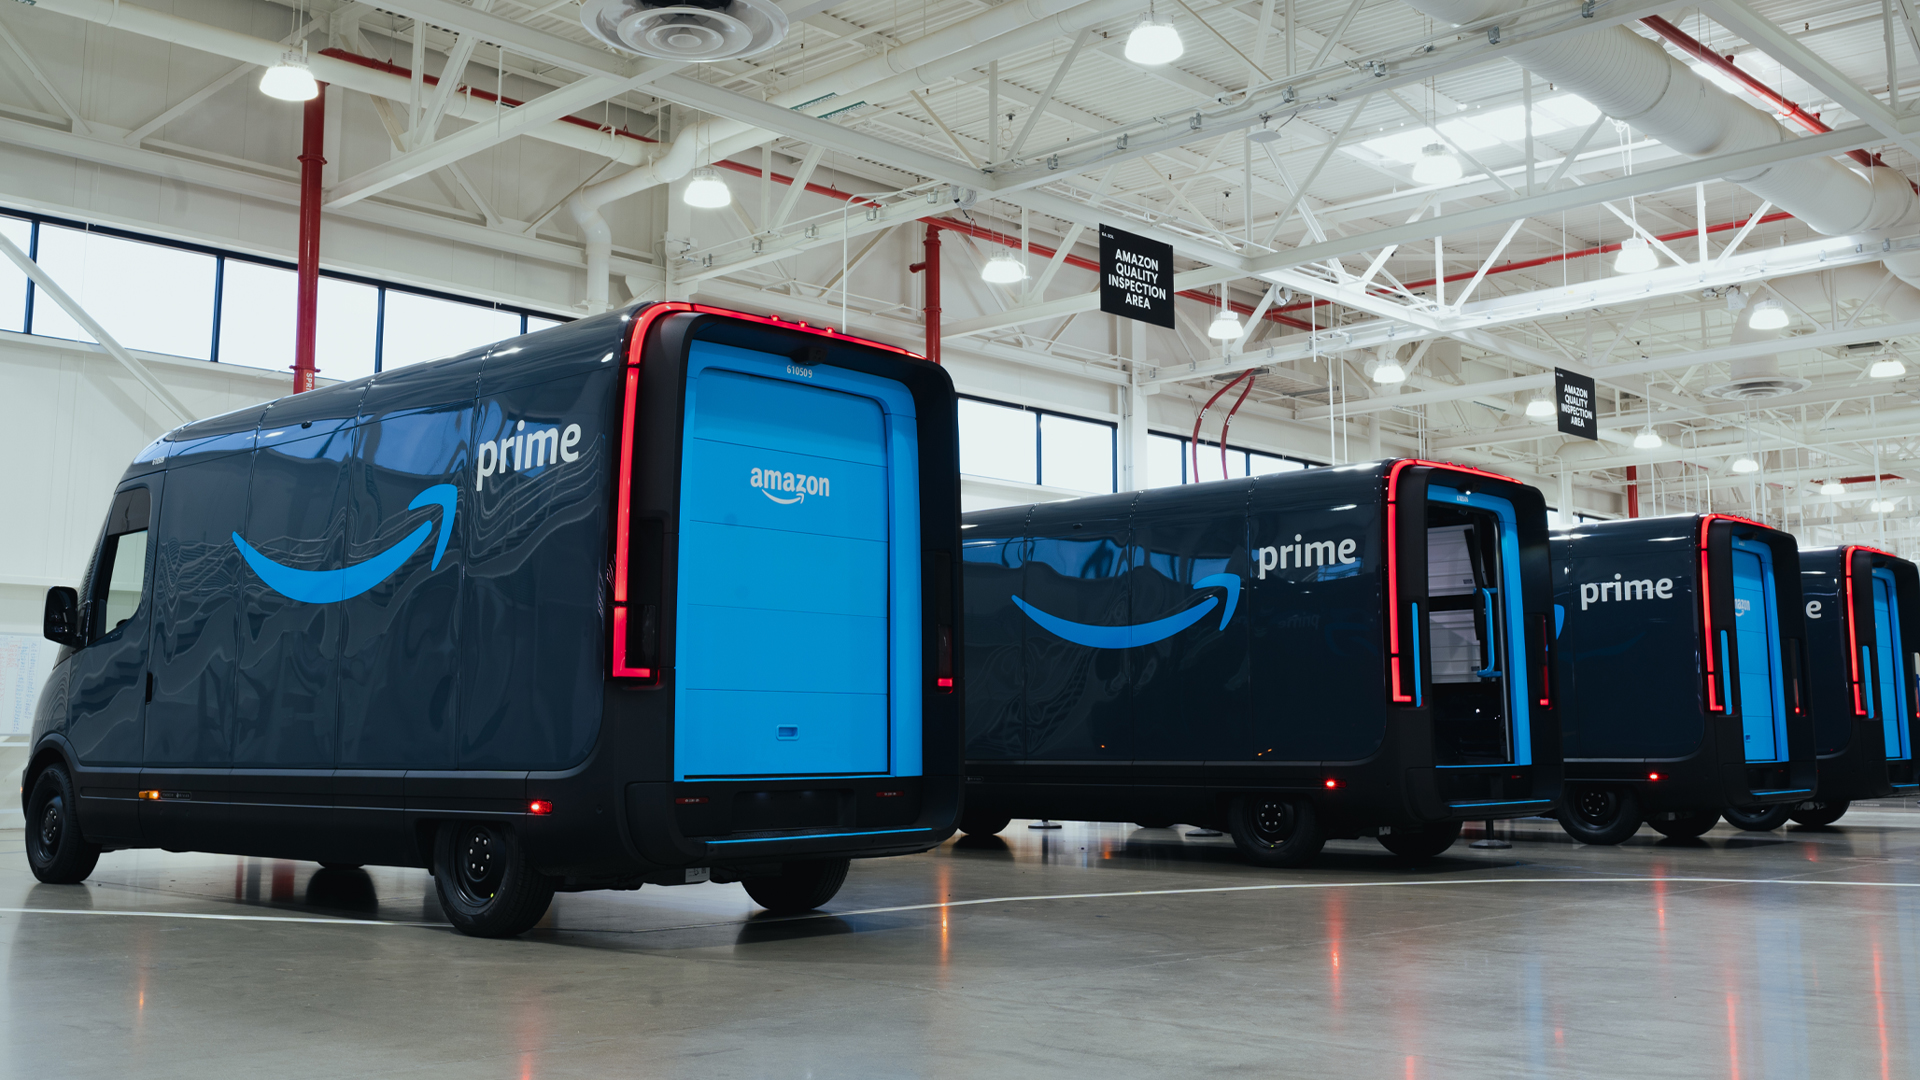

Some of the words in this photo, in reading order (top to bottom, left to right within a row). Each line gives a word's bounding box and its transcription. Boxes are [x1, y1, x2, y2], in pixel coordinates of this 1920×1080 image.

[1115, 248, 1159, 271] AMAZON
[1115, 262, 1158, 284] QUALITY
[1108, 273, 1166, 301] INSPECTION
[1125, 292, 1151, 310] AREA
[786, 364, 813, 378] 610509
[1563, 383, 1588, 399] AMAZON
[1560, 402, 1593, 420] INSPECTION
[1564, 394, 1588, 409] QUALITY
[1570, 415, 1585, 428] AREA
[476, 419, 581, 492] prime
[750, 467, 830, 497] amazon
[1258, 533, 1357, 580] prime
[1580, 573, 1673, 611] prime
[1734, 598, 1750, 611] mazon
